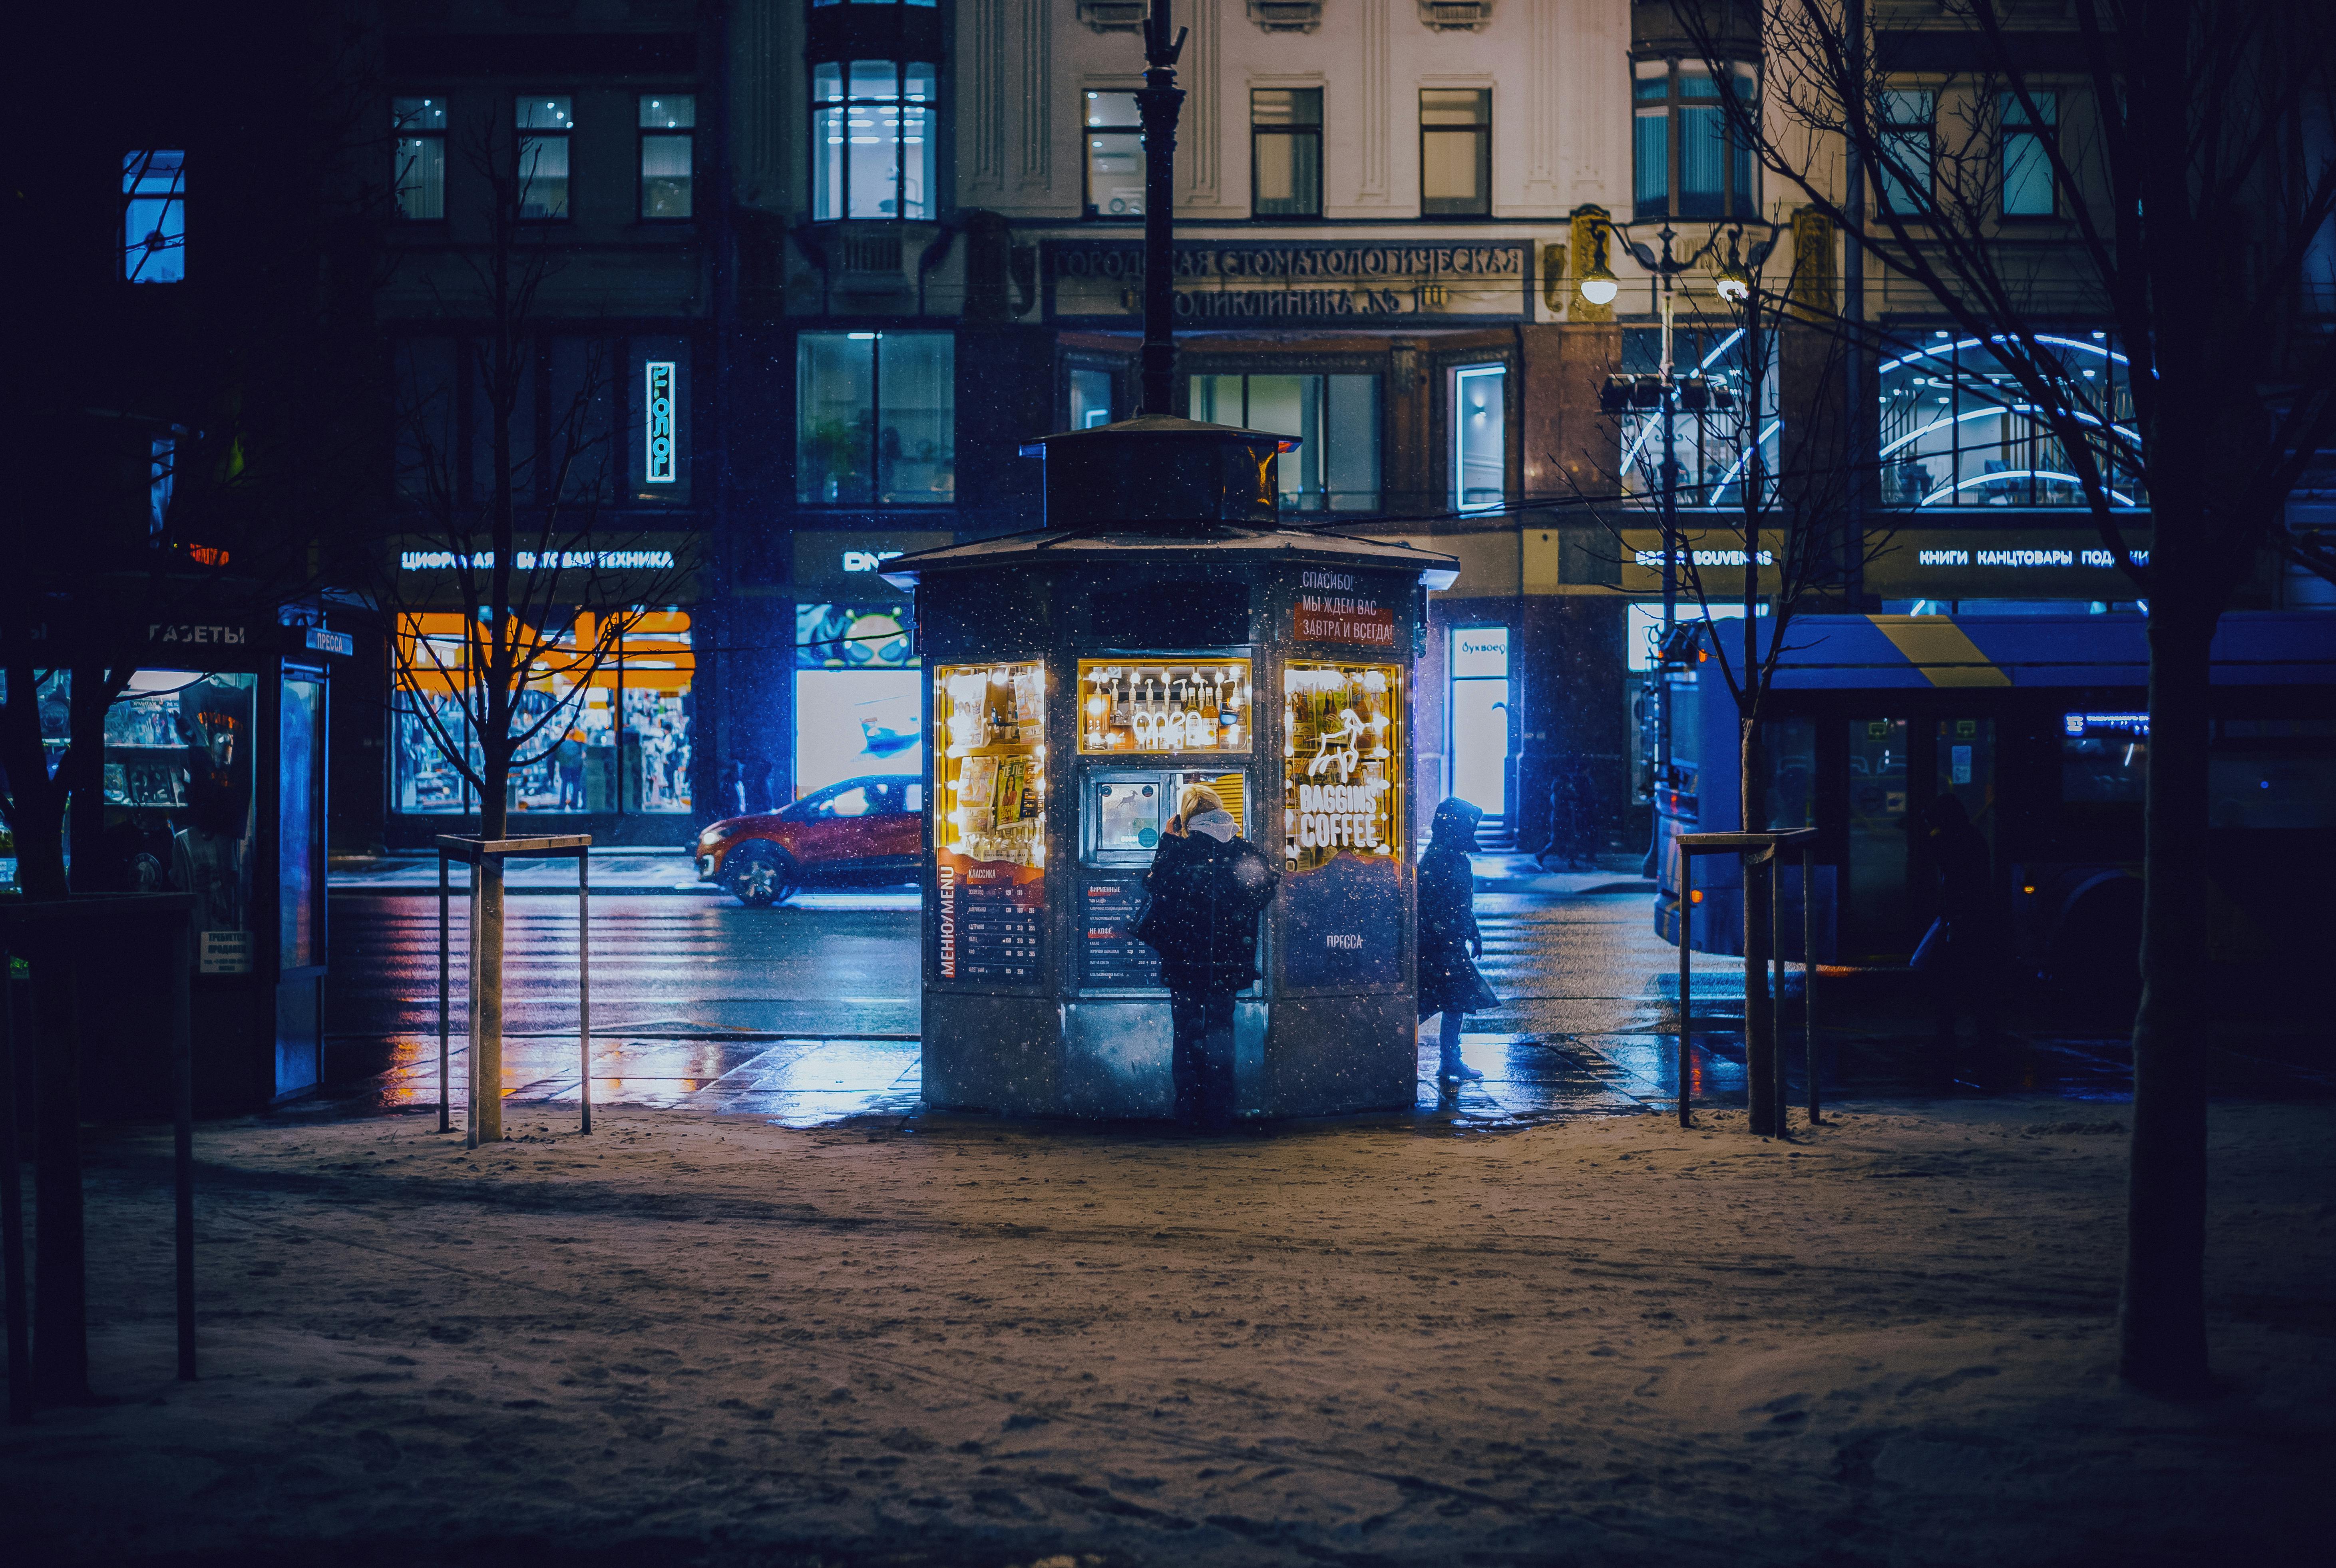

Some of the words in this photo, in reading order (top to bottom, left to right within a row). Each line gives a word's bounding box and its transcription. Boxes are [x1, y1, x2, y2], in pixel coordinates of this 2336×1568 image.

[1054, 250, 1208, 276] ГОРОДАЯ
[1219, 249, 1519, 276] СТОМАТОЛОГИЧЕСКАЯ
[1153, 291, 1353, 316] ОЛИКЛИНИКА
[598, 551, 674, 569] ТЕХНИКА
[1693, 550, 1772, 565] SOUVENRS
[1920, 550, 1969, 565] КНИГИ
[1977, 550, 2073, 567] КАНЦТОВАРЫ
[1303, 571, 1353, 591] СПАСИБО!
[1302, 595, 1320, 611] МЫ
[1324, 597, 1354, 615] ЖДЕМ
[1358, 599, 1377, 616] ВАС
[1303, 619, 1340, 637] ЗАВТРА
[1344, 622, 1350, 637] И
[1353, 623, 1393, 642] ВСЕГДА!
[317, 633, 343, 652] ПРЕССА
[1462, 641, 1506, 655] буквоед
[1300, 784, 1377, 814] BAGGINS
[1301, 814, 1377, 848] COFFEE
[968, 869, 996, 878] КЛАССИКА
[941, 866, 954, 975] МЕНЮ/MENU
[1327, 934, 1362, 949] ПРЕССА
